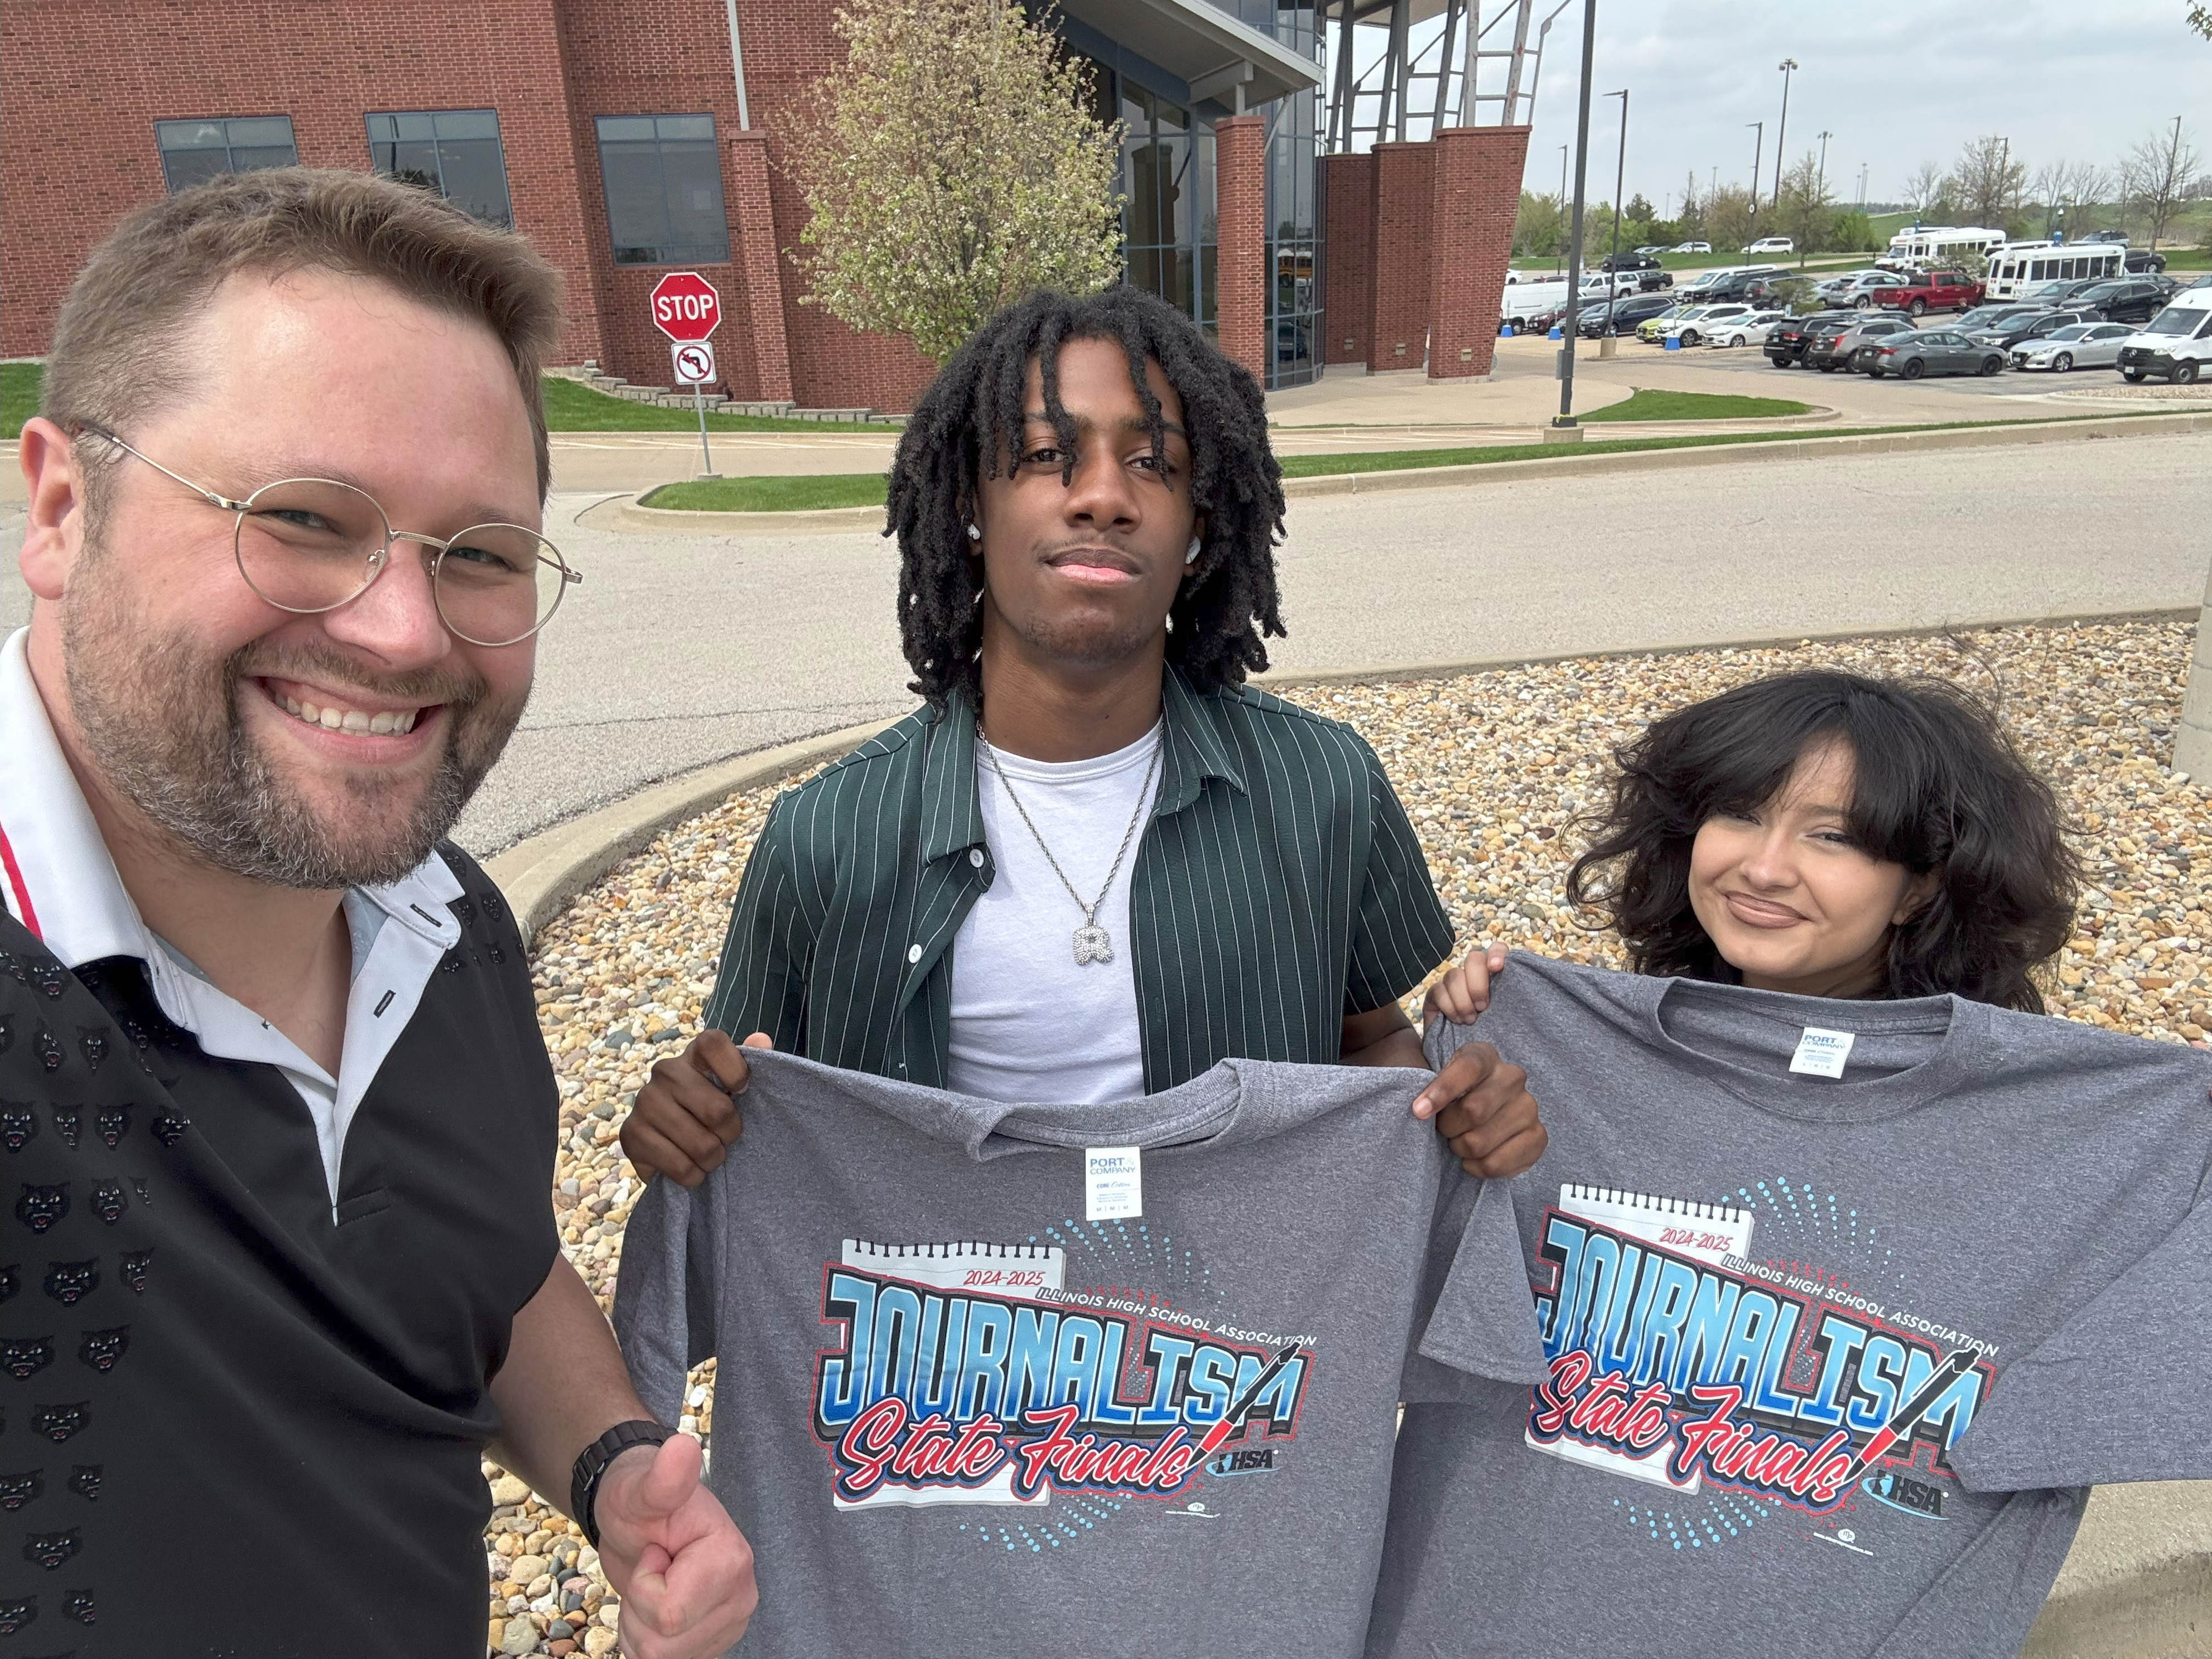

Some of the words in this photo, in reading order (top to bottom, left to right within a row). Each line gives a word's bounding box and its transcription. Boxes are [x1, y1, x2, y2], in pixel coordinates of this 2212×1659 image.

[657, 294, 714, 321] STOP
[1805, 1035, 1837, 1044] PORT
[1090, 1158, 1125, 1167] PORT
[1659, 1227, 1732, 1252] 2024-2025
[963, 1270, 1045, 1285] 2024-2025
[1037, 1287, 1103, 1308] ILLINOIS
[1107, 1298, 1144, 1315] HIGH
[1151, 1306, 1211, 1332] SCHOOL
[1216, 1324, 1317, 1346] ASSOCIATION
[1722, 1254, 1782, 1283] ILLINOIS
[1786, 1275, 1822, 1296] HIGH
[1825, 1287, 1885, 1319] SCHOOL
[1890, 1311, 1999, 1357] ASSOCIATION
[818, 1273, 1306, 1426] JOURNALISM
[1538, 1219, 1981, 1450] JOURNALISM
[841, 1397, 1005, 1488] State
[1020, 1403, 1195, 1488] Finals
[1536, 1350, 1671, 1446] State
[1672, 1383, 1853, 1502] Finals
[1216, 1449, 1273, 1474] IHSA
[1872, 1469, 1941, 1515] IHSA
